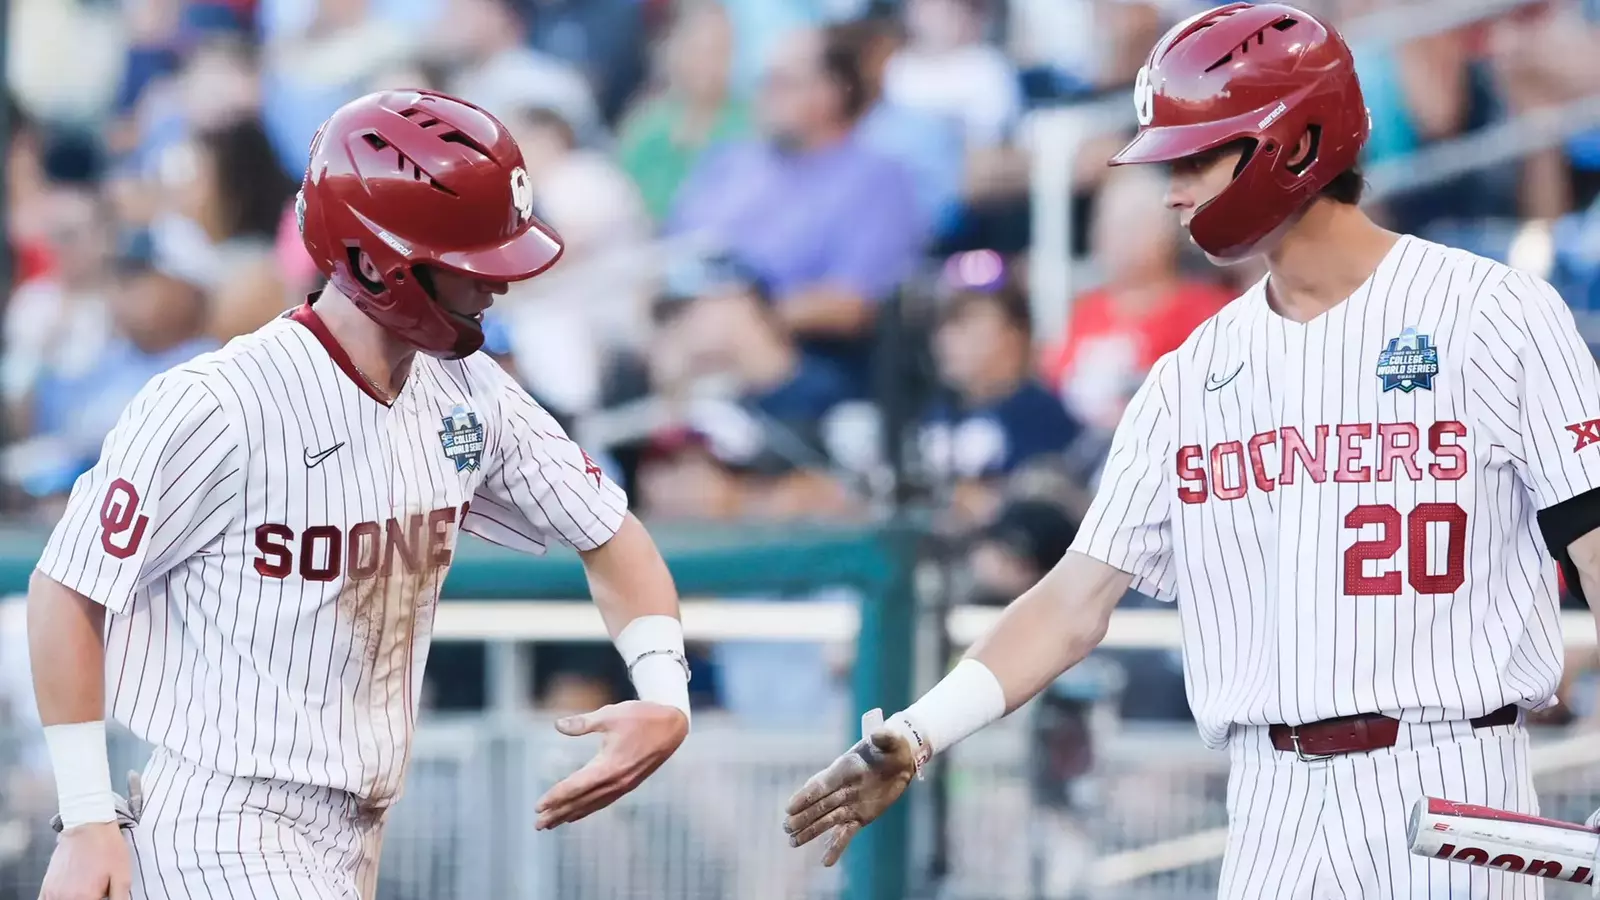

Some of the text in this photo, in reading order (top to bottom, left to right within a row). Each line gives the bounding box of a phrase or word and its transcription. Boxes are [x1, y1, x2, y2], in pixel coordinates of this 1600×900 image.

[1258, 101, 1287, 130] marucci
[378, 230, 413, 257] marucci
[1377, 363, 1437, 376] WORLD SERIES
[1389, 354, 1424, 365] COLLEGE
[445, 443, 469, 457] WORLD
[453, 432, 478, 446] COLLEGE
[100, 477, 149, 560] OU
[253, 500, 470, 582] SOONE
[1343, 502, 1468, 596] 20
